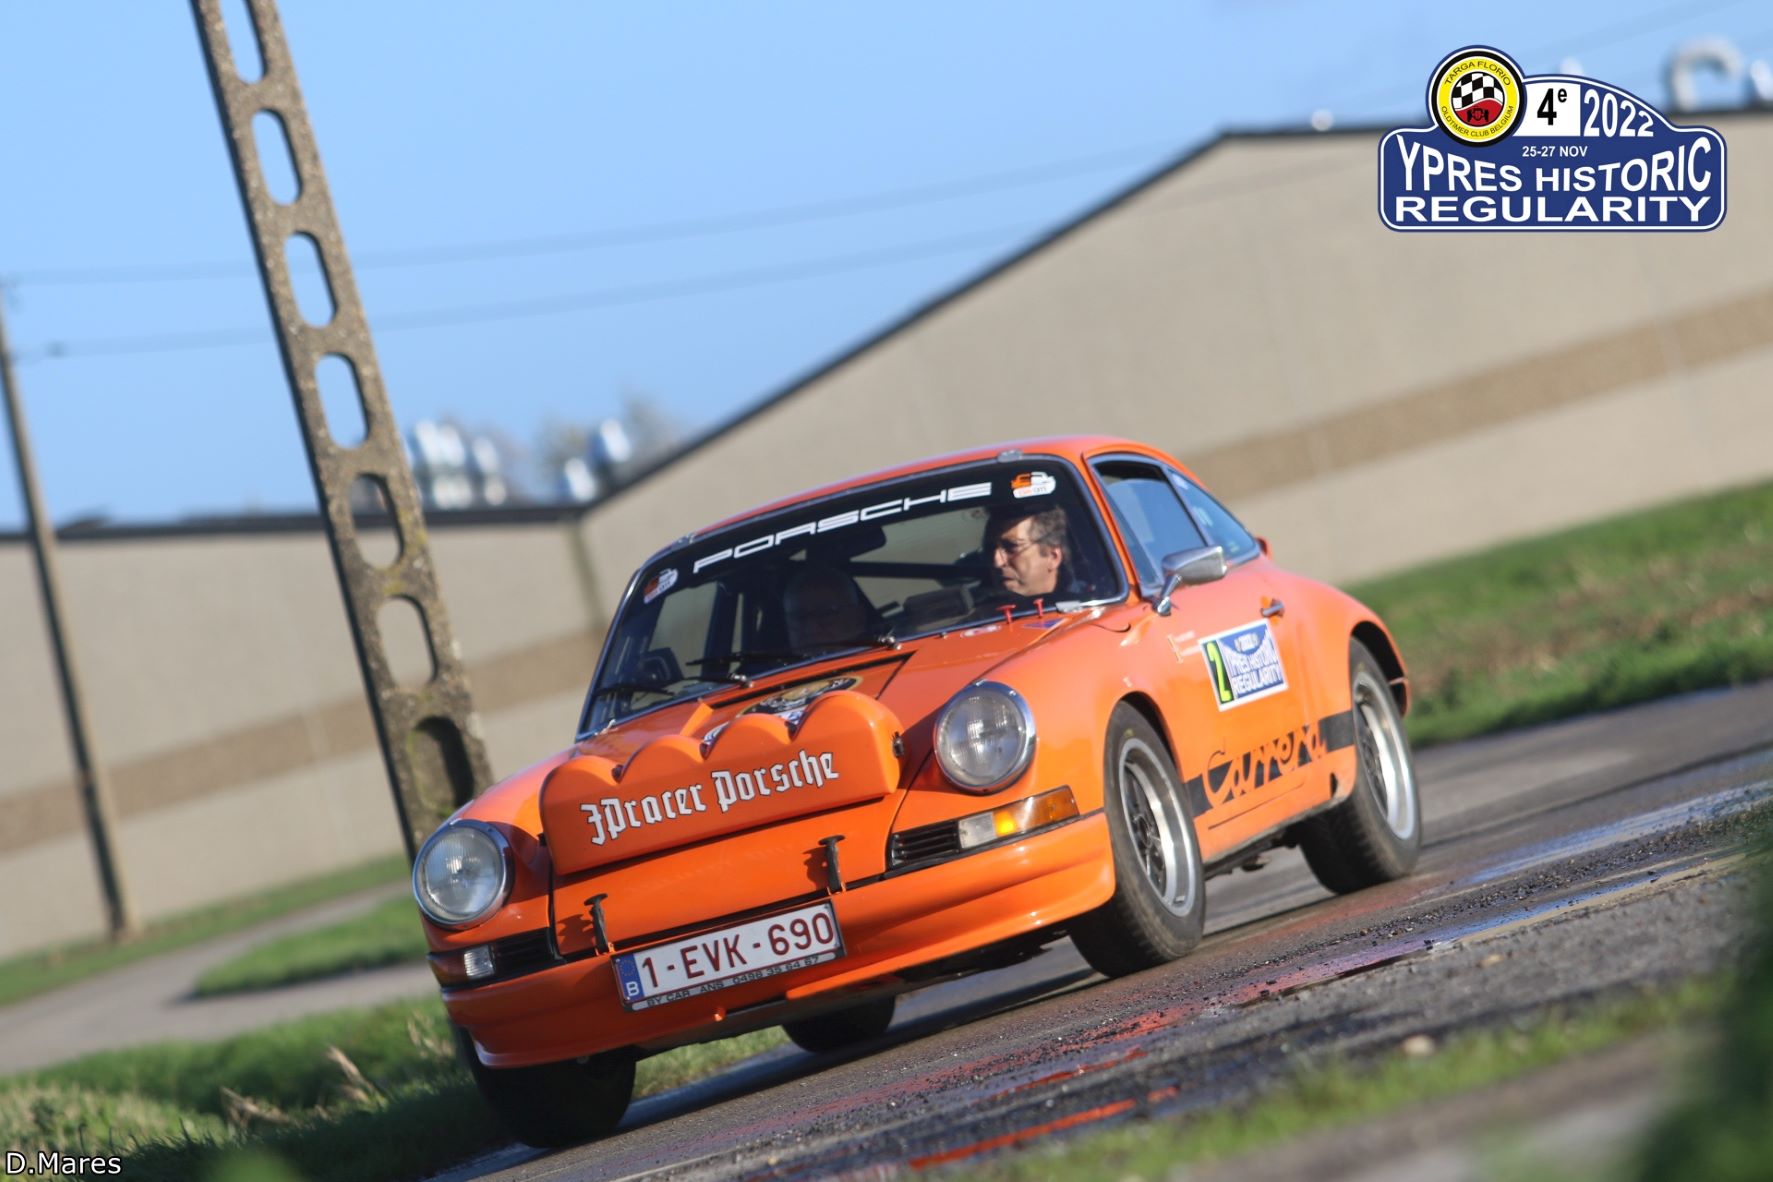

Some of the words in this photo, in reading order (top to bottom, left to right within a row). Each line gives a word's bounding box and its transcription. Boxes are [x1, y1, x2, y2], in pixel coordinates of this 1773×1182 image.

[693, 482, 992, 574] PORSCHE
[1206, 640, 1233, 702] 2
[711, 749, 840, 813] Porsche
[625, 980, 640, 997] B
